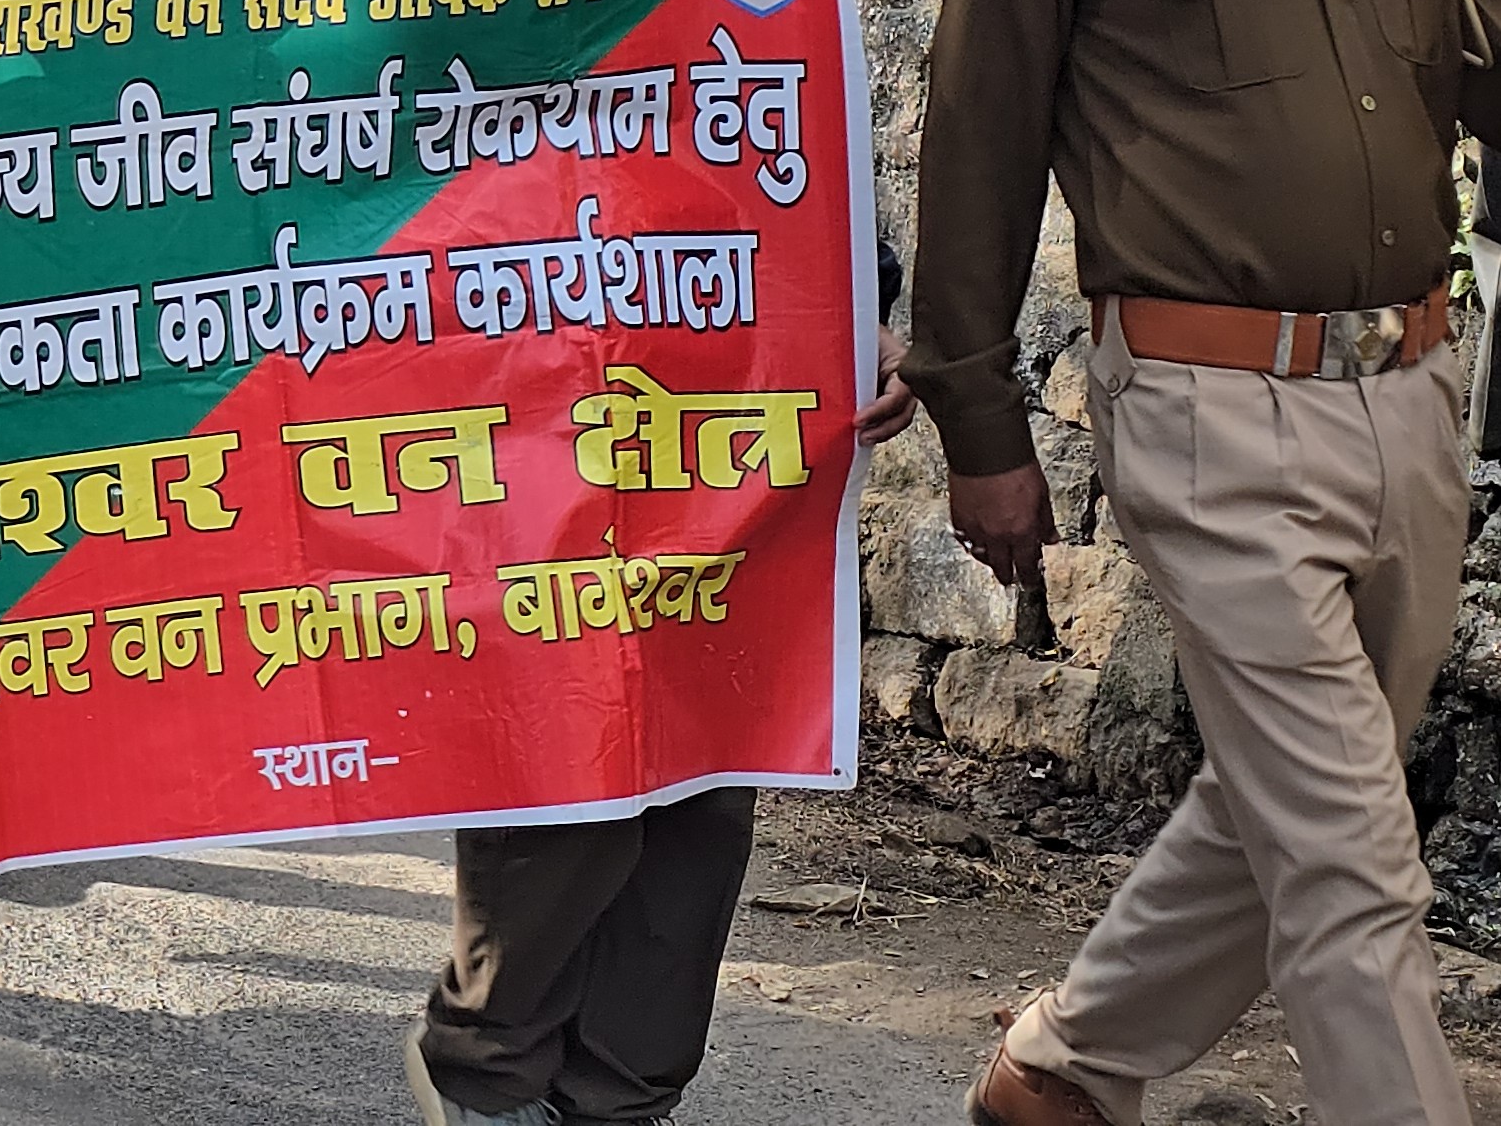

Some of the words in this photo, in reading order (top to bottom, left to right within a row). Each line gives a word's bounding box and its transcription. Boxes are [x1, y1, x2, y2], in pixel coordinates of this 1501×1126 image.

[70, 79, 218, 211] जीव
[231, 56, 404, 193] संघर्ष
[414, 54, 675, 174] रोकथाम
[690, 25, 808, 205] हेतु
[153, 222, 434, 376] कार्यक्रम
[447, 196, 759, 338] कार्यशाला
[282, 403, 509, 517] वन
[571, 364, 819, 491] क्षेत्र
[105, 593, 224, 682] वन
[239, 573, 478, 690] प्रभाग,
